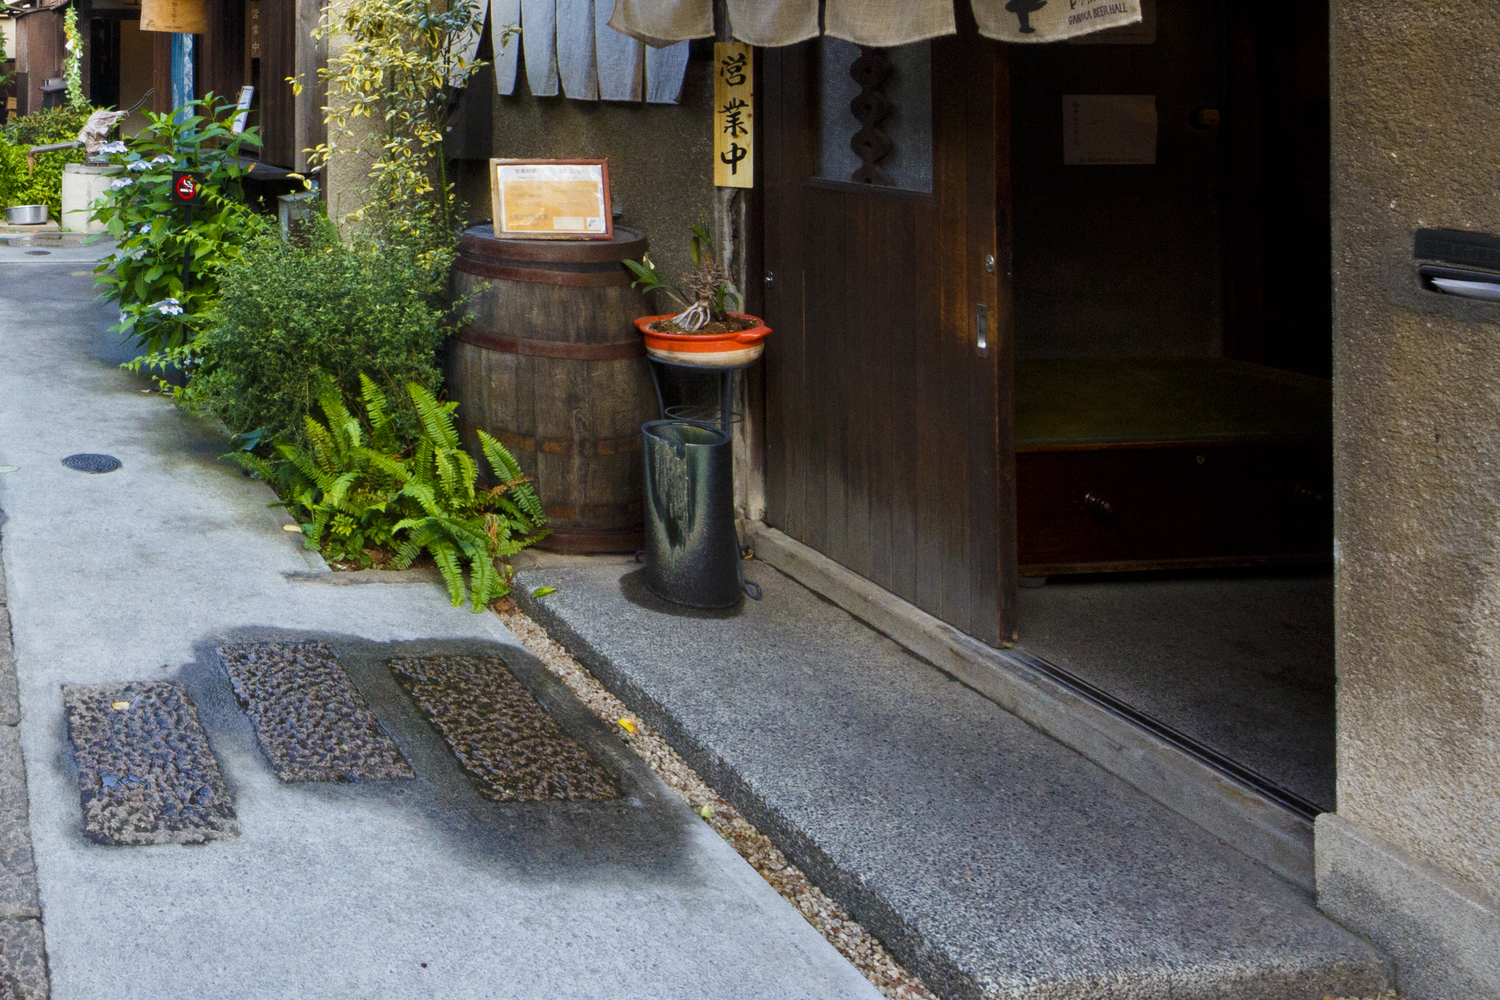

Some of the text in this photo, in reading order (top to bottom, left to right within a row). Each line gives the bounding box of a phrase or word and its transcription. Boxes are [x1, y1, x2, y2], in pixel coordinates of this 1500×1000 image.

[1092, 5, 1109, 19] BEER
[1108, 2, 1128, 14] HALL
[717, 52, 750, 176] 営業中
